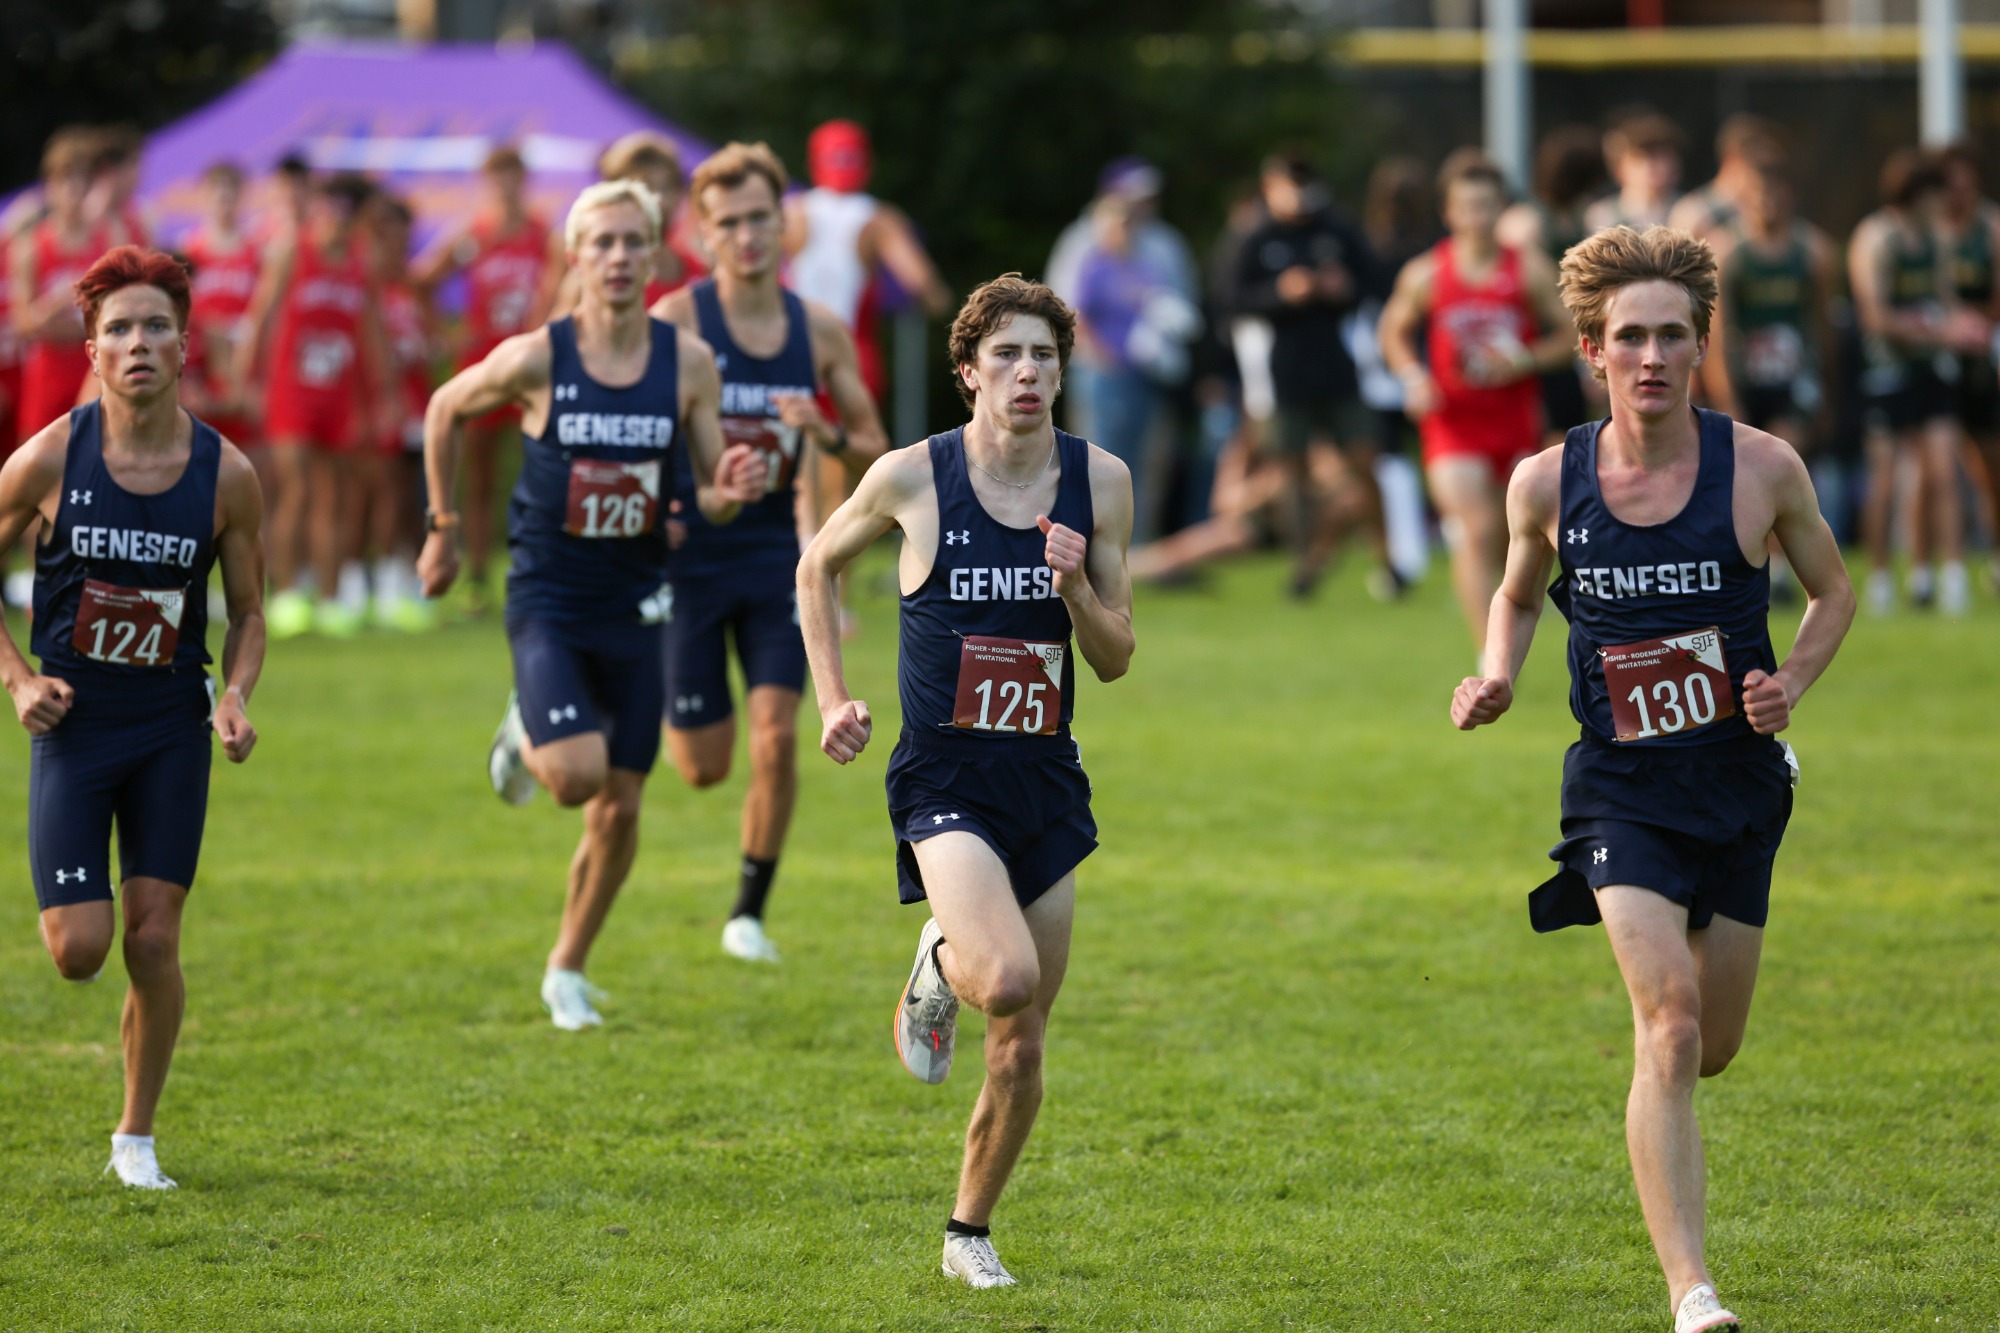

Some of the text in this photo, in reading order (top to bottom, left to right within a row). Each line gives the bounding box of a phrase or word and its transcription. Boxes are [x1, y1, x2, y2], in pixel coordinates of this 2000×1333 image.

[558, 413, 673, 448] GENESEO
[581, 492, 646, 537] 126
[72, 525, 197, 568] GENESEO
[950, 567, 1062, 601] GENES
[1575, 560, 1721, 600] GENESEO
[87, 618, 162, 666] 124
[965, 644, 987, 652] FISHER
[991, 646, 1028, 656] RODENBECK
[975, 653, 1017, 663] INVITATIONAL
[1044, 646, 1063, 664] SJF
[1605, 653, 1627, 663] FISHER
[1630, 646, 1671, 659] RODENBECK
[1691, 632, 1716, 652] SJF
[1616, 658, 1662, 670] INVITATIONAL
[972, 679, 1048, 734] 125
[1627, 672, 1716, 738] 130
